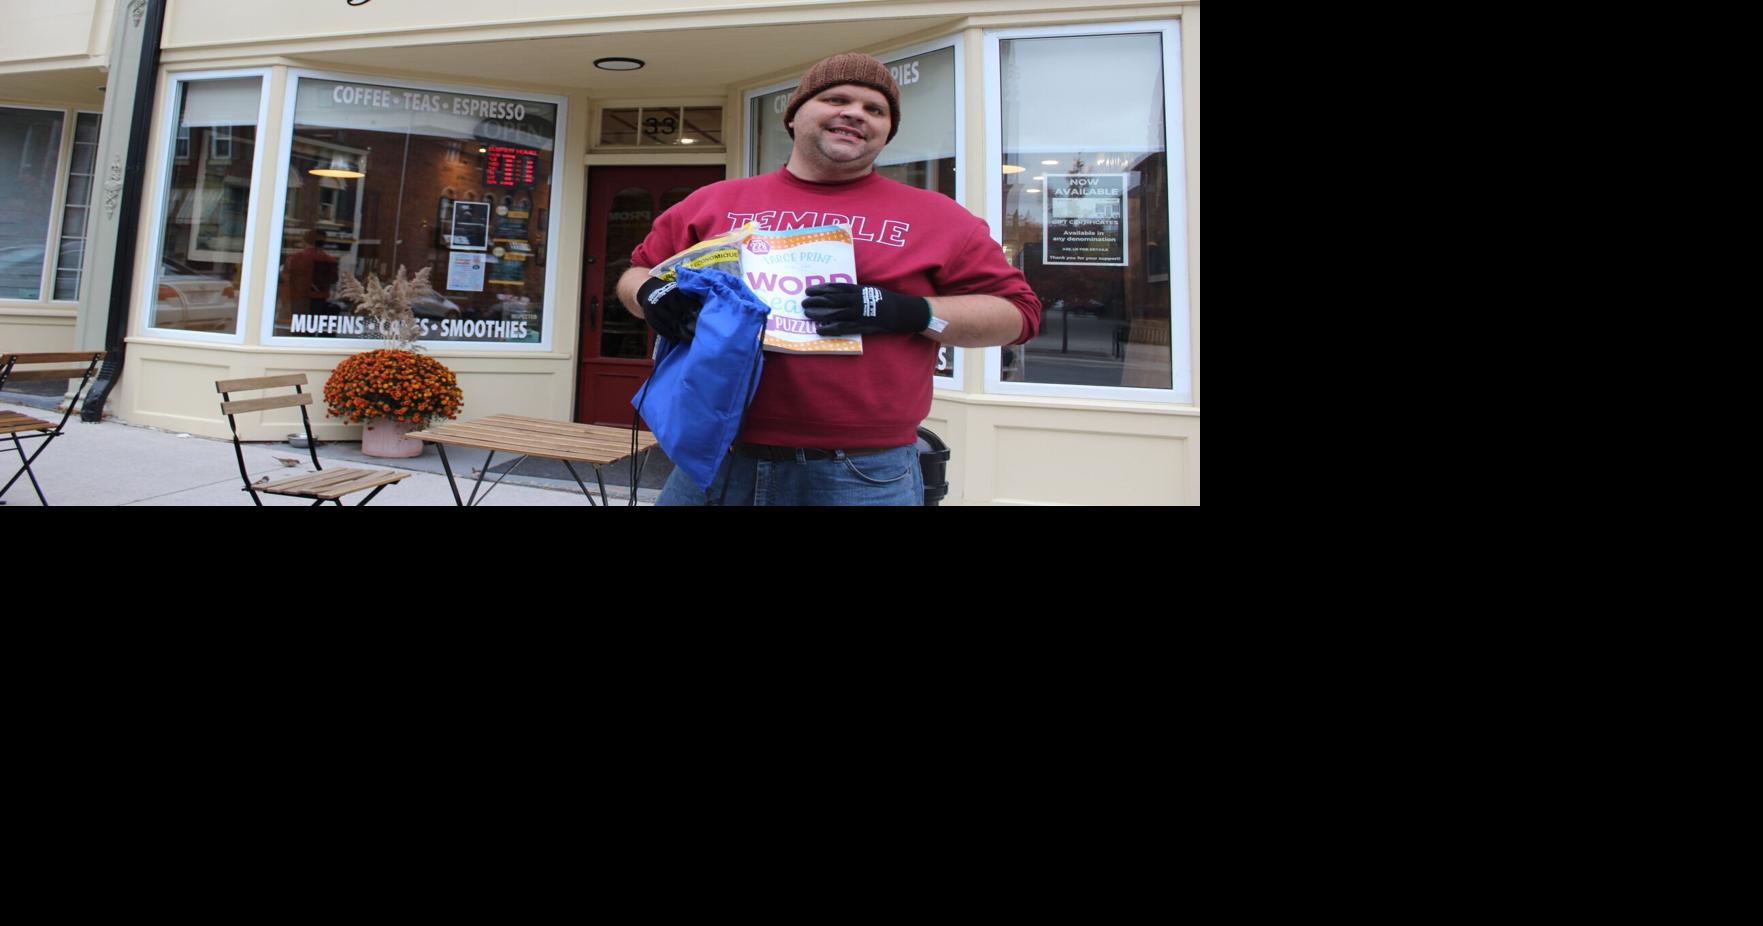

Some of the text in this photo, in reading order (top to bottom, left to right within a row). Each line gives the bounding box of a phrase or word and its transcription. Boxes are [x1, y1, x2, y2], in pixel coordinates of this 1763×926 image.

[333, 85, 525, 121] COFFEE TEAS ESPRESSO
[483, 120, 544, 143] OPEN
[644, 117, 676, 135] 33
[1070, 178, 1099, 186] NOW
[1054, 188, 1119, 196] AVAILABLE
[727, 210, 909, 247] TEMPLE
[800, 252, 833, 265] PRINT
[290, 313, 364, 335] MUFFINS
[440, 319, 528, 339] SMOOTHIES
[775, 316, 819, 334] PUZZL
